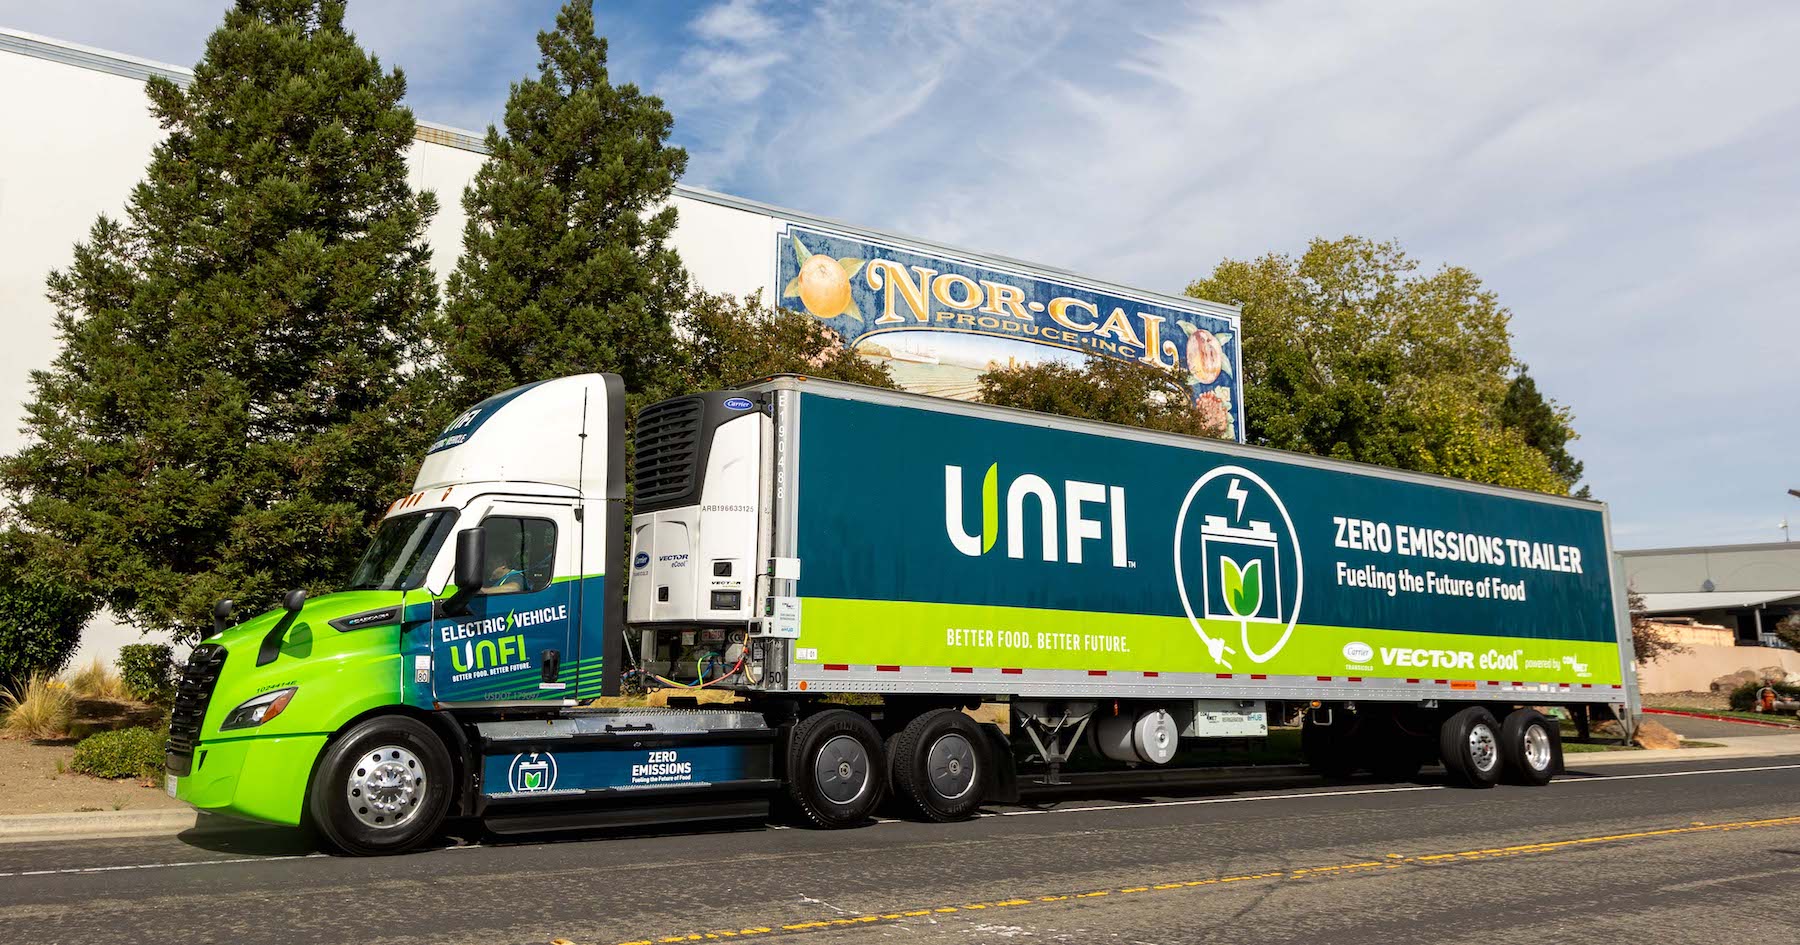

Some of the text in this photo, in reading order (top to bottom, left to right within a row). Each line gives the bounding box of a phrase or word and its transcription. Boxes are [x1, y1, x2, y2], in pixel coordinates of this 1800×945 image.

[727, 399, 750, 409] Carrier
[945, 461, 1128, 568] UNFI
[1333, 516, 1583, 574] ZERO EMISSIONS TRAILER
[1336, 561, 1526, 601] Fueling the Future of Food
[441, 604, 567, 643] ELECTRIC VEHICLE
[946, 628, 1130, 653] BETTER FOOD. BETTER FUTURE.
[450, 634, 527, 673] UNFI
[1380, 647, 1561, 672] VECTOR eCool powered by
[452, 673, 473, 683] BETTER
[489, 666, 510, 676] BETTER
[510, 661, 532, 672] FUTURE.
[769, 672, 782, 684] 50
[484, 692, 511, 700] USDOT
[631, 762, 692, 776] EMISSIONS
[648, 750, 677, 763] ZERO
